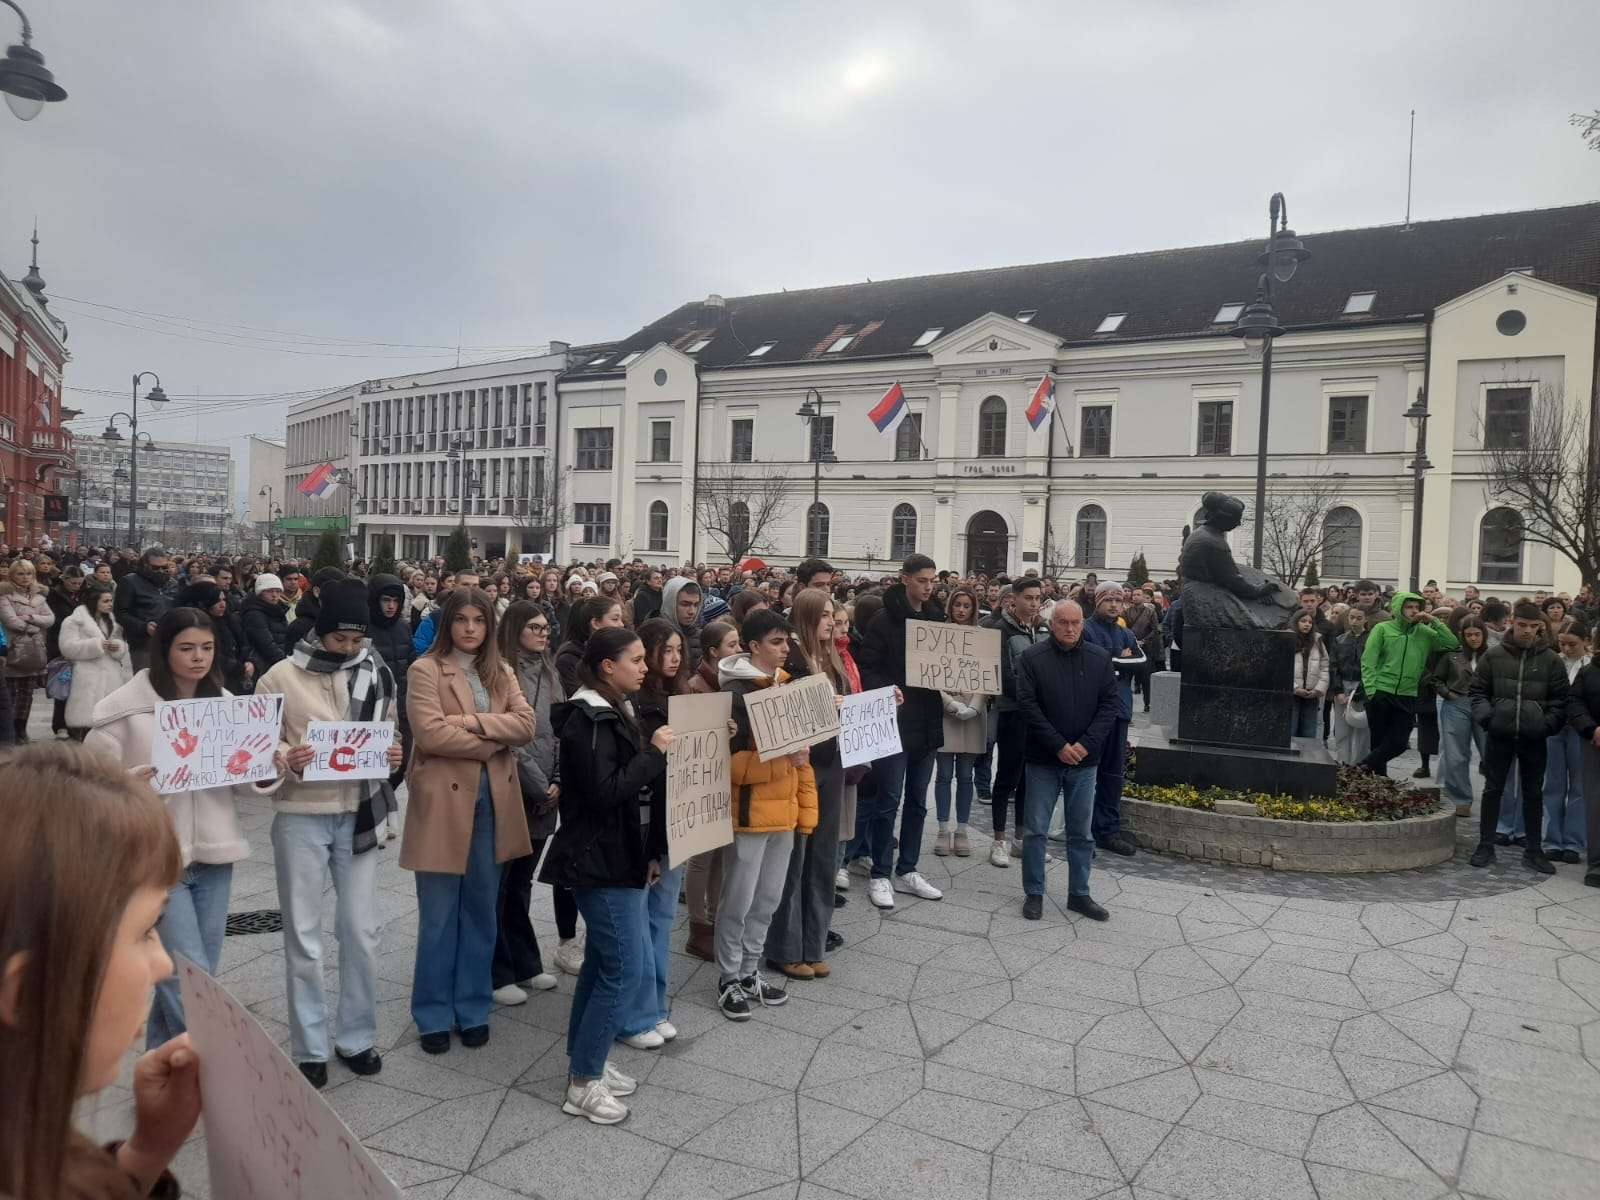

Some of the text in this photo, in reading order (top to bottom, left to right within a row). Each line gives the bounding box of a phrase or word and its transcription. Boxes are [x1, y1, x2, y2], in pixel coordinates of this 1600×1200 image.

[916, 626, 975, 656] РУКЕ
[940, 655, 952, 667] СУ
[920, 663, 1000, 692] КРВАВЕ!
[844, 718, 897, 753] БОРБОМ!
[201, 745, 233, 768] НЕ
